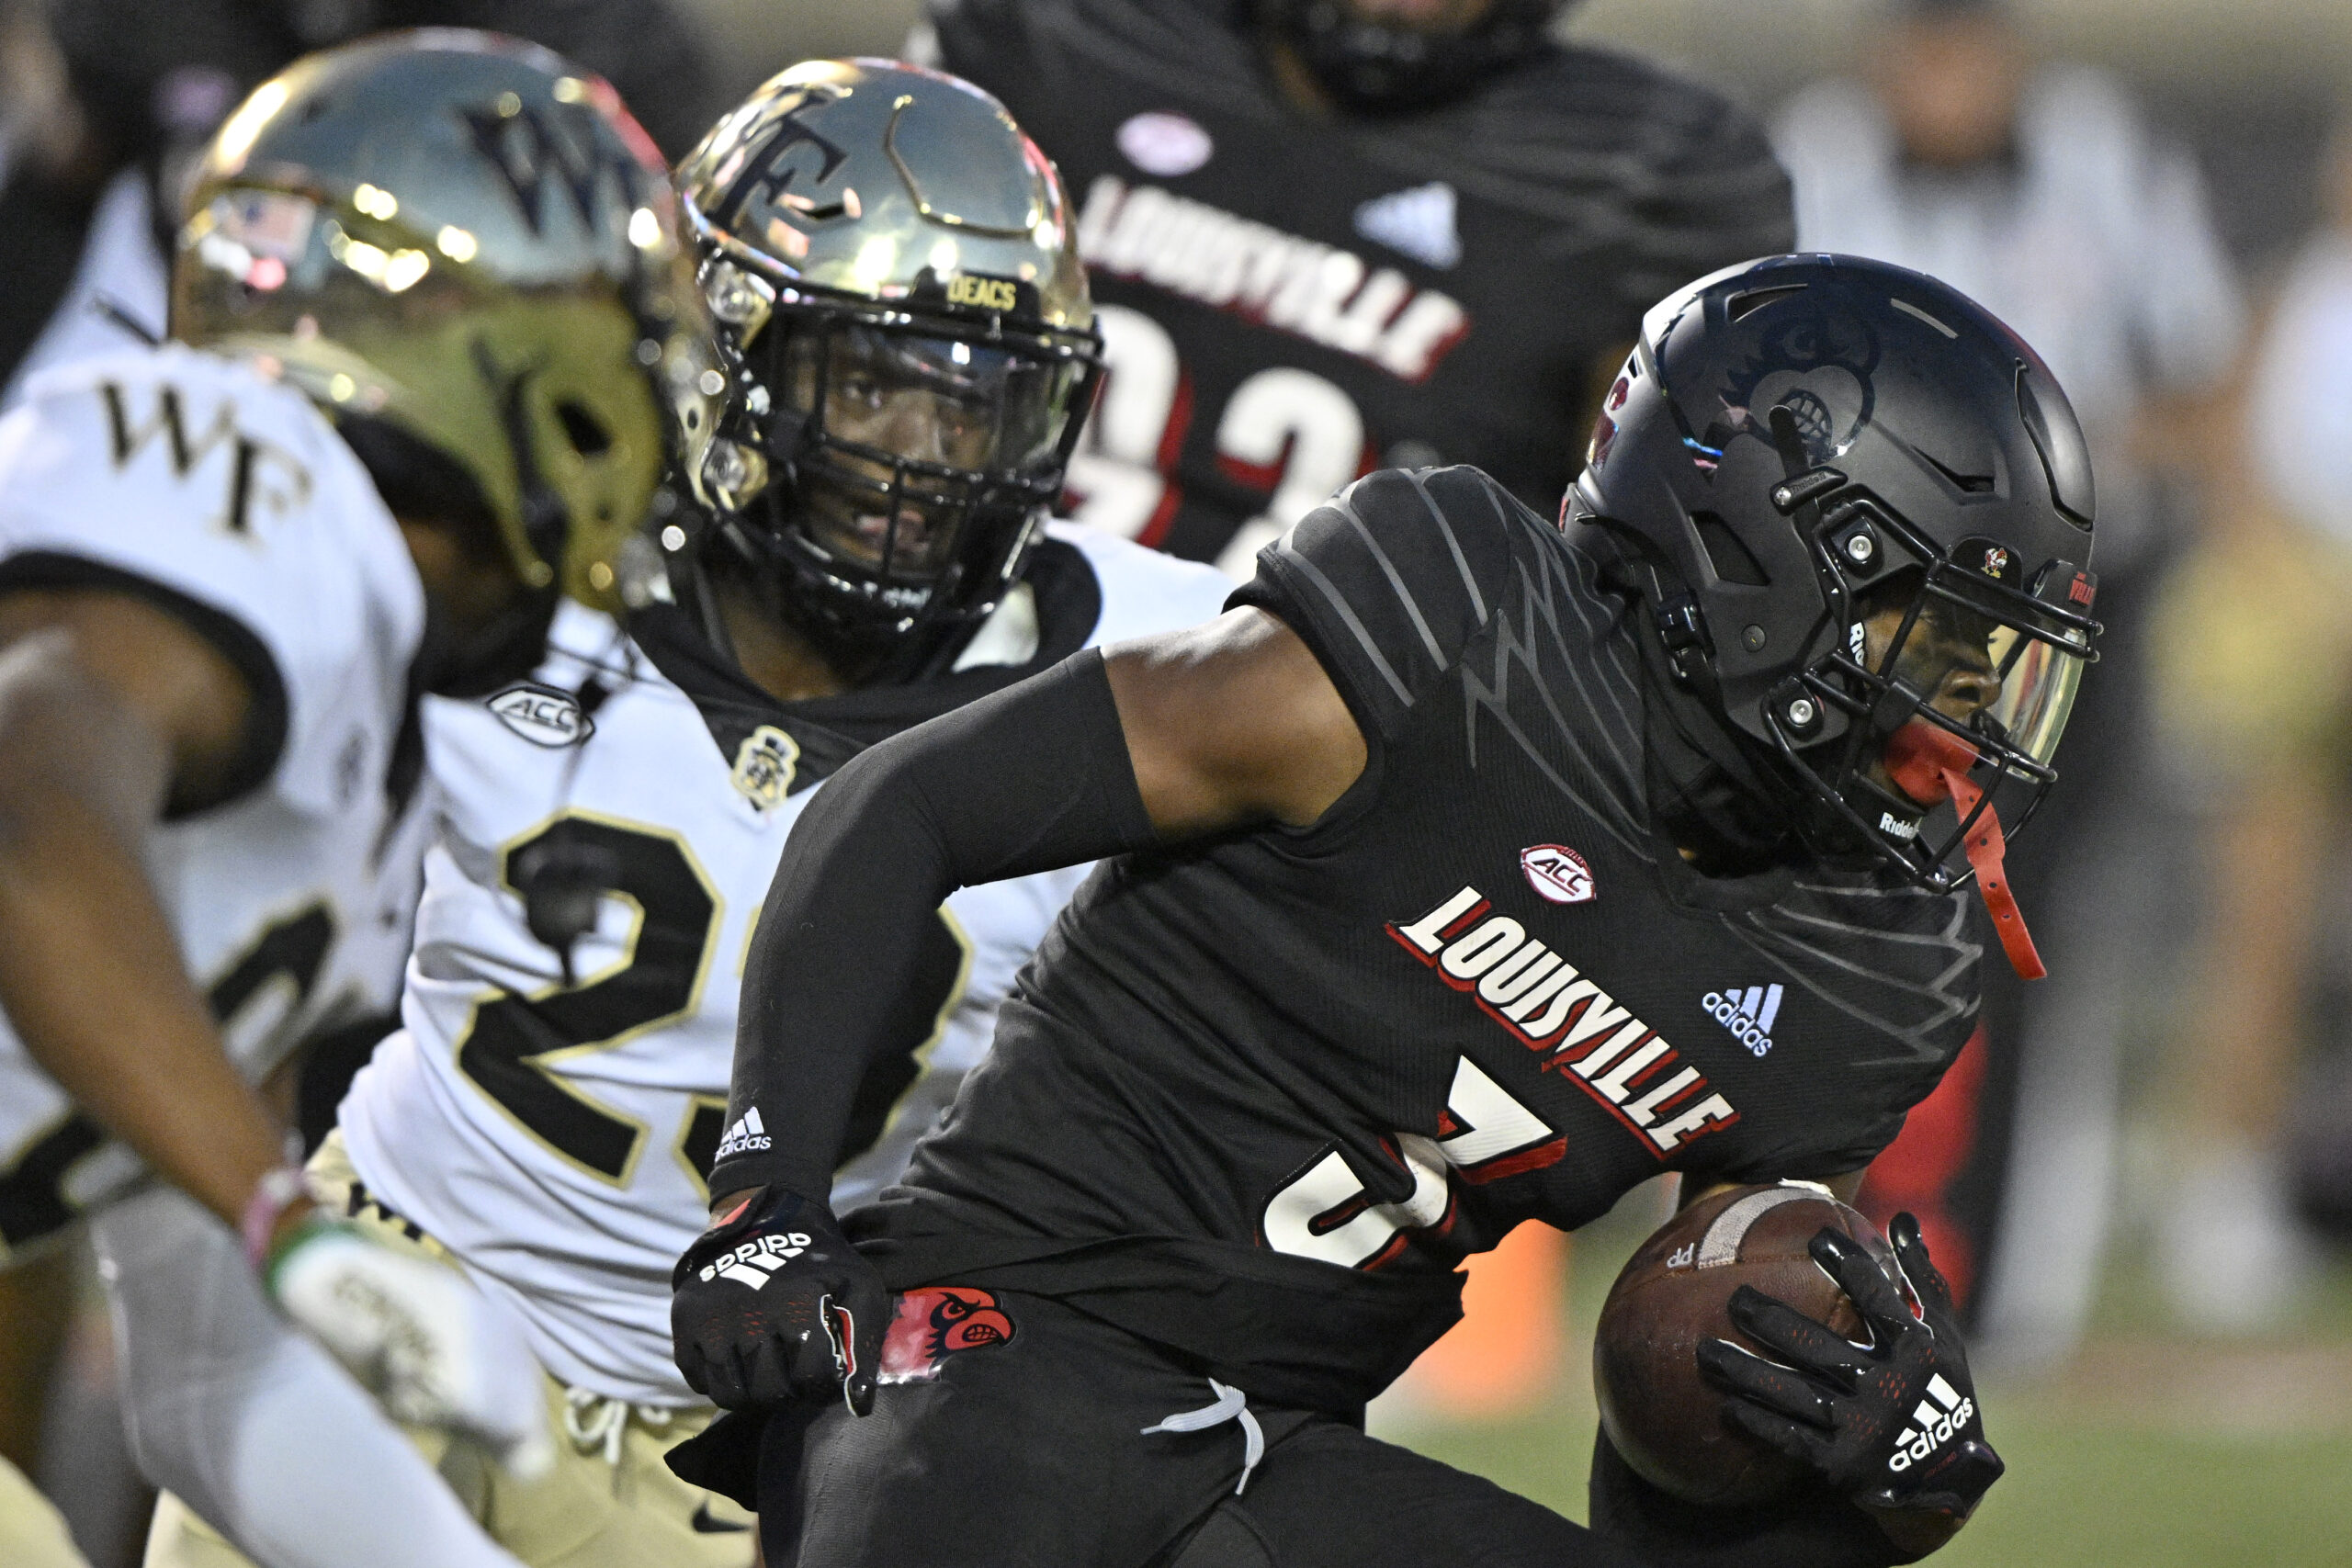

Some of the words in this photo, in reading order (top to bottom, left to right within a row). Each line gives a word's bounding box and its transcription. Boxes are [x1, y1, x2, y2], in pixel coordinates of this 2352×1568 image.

[947, 276, 1016, 311] DEACS
[502, 698, 579, 732] ACC
[1532, 857, 1593, 894] ACC
[1387, 884, 1739, 1159] LOUISVILLE
[1702, 992, 1773, 1057] adidas
[699, 1232, 812, 1282] adidas
[1889, 1397, 1973, 1472] adidas
